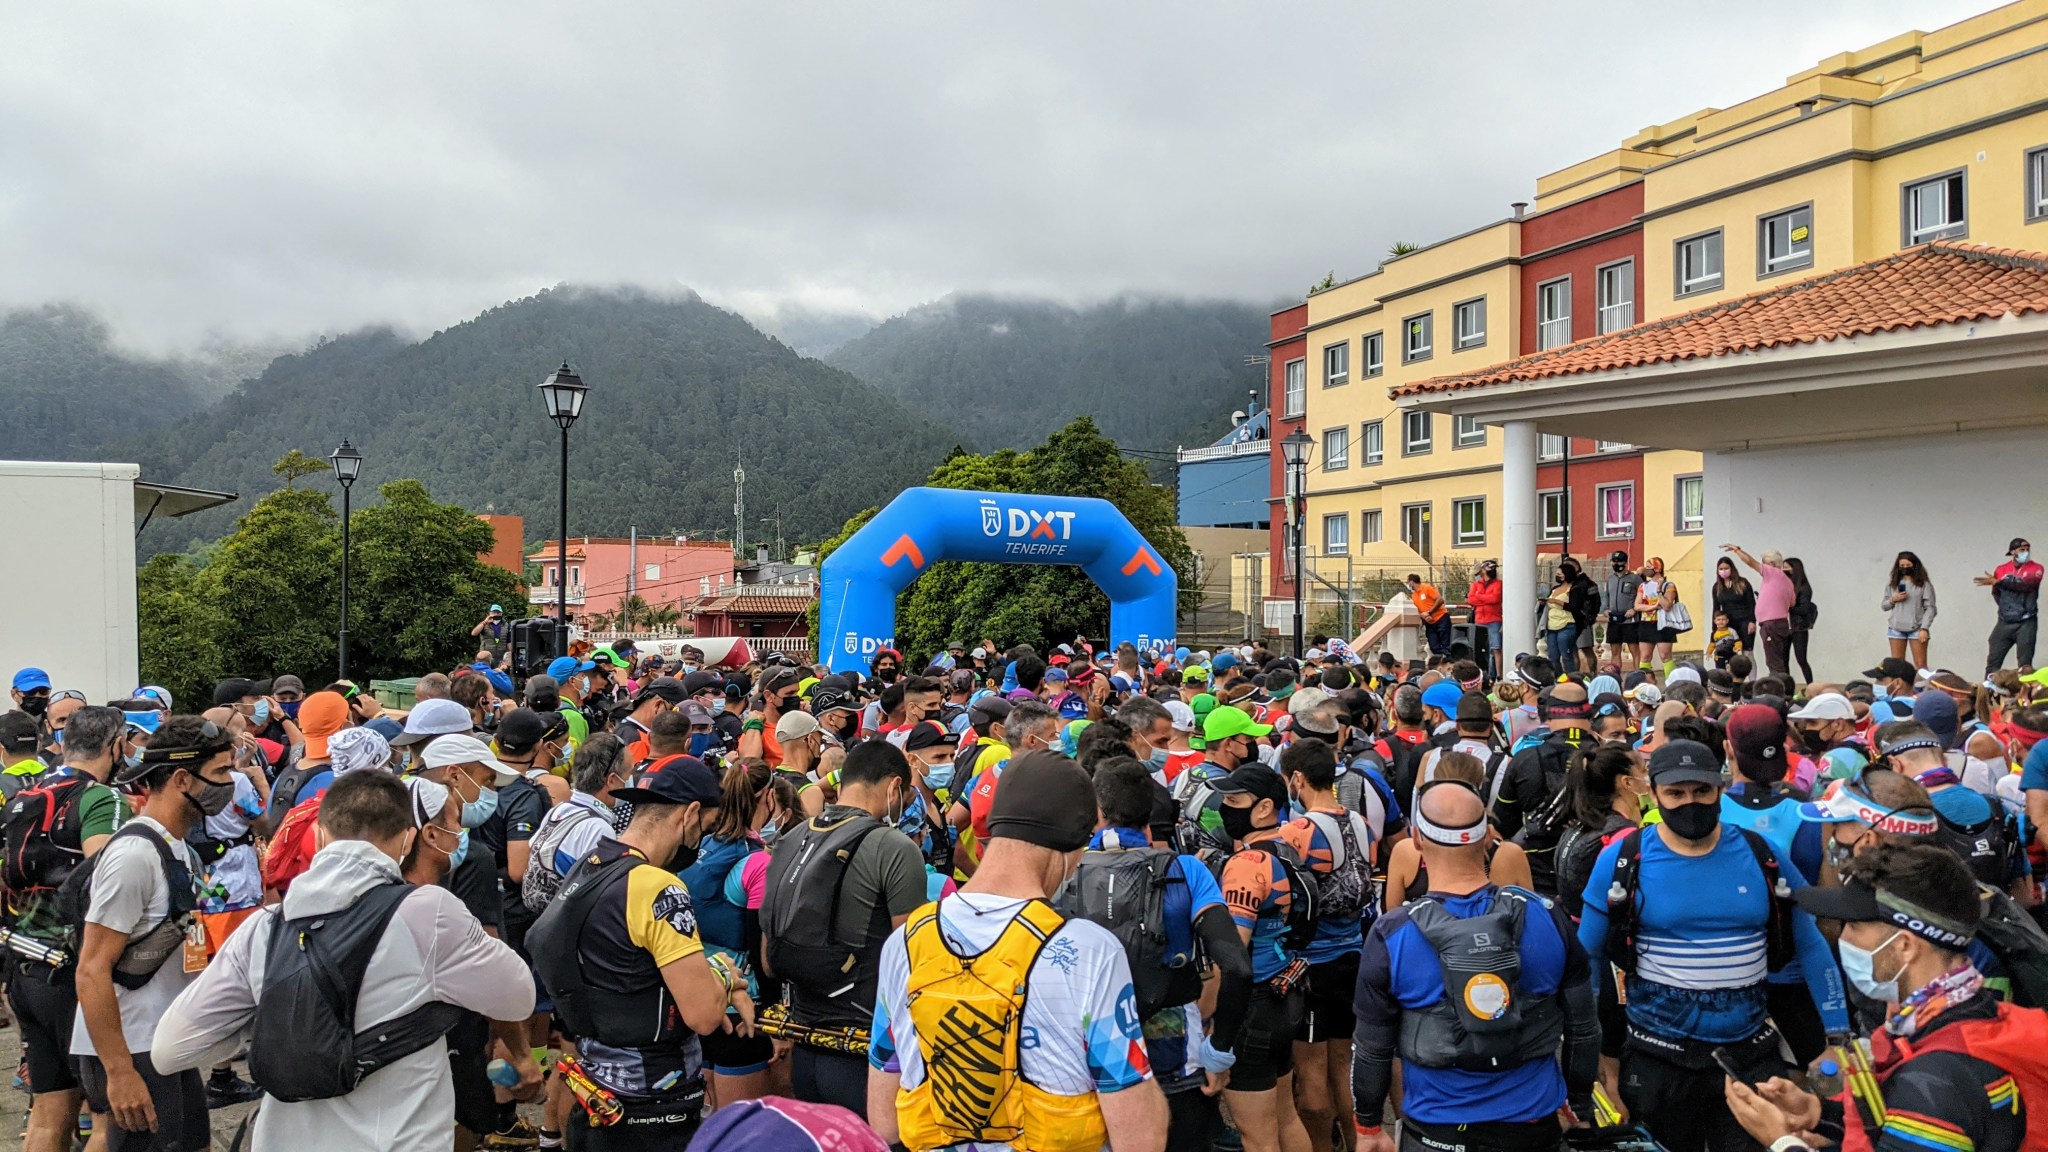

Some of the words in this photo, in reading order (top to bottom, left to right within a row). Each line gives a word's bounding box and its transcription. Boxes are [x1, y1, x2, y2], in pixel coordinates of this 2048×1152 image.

[1008, 508, 1076, 540] DXT
[1005, 542, 1068, 556] TENERIFE
[1152, 638, 1177, 654] DX
[1892, 912, 1971, 948] COMPR
[627, 1116, 664, 1125] Kalenji
[1421, 1136, 1455, 1151] salomon
